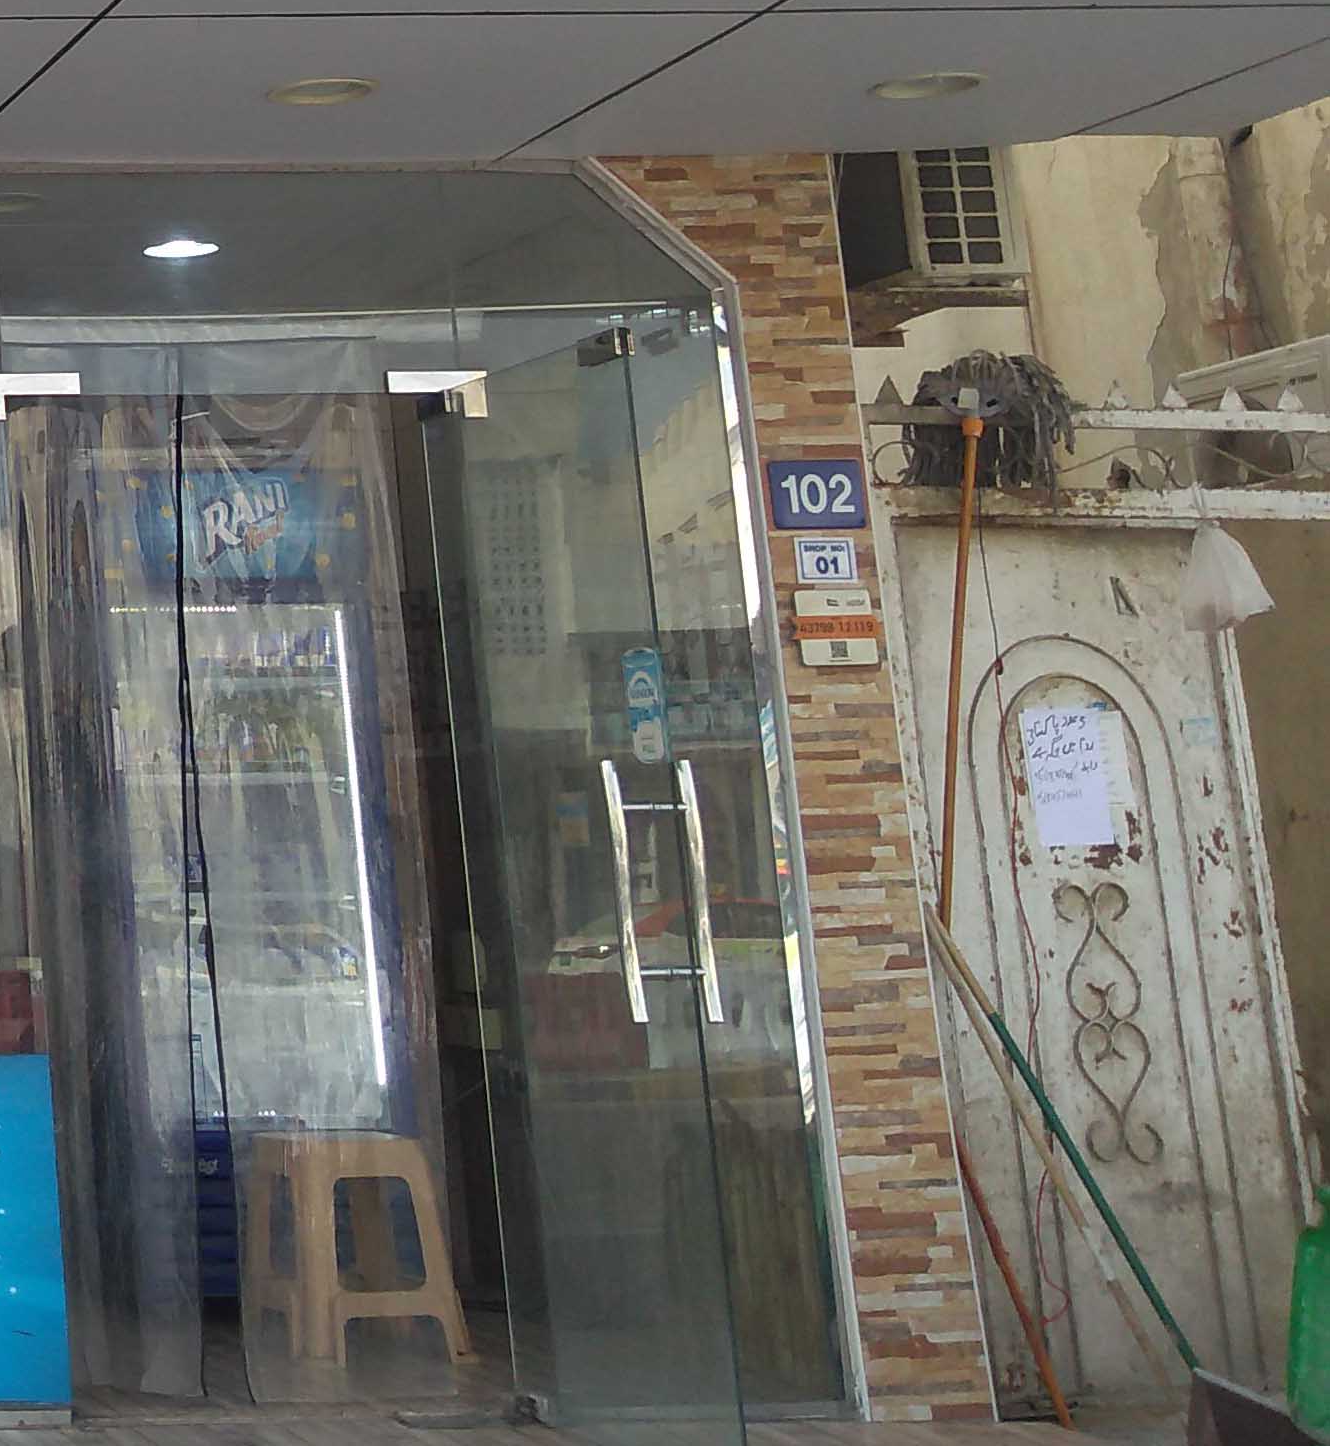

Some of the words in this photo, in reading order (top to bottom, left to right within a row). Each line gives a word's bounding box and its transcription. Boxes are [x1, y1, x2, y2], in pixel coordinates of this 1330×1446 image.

[781, 473, 856, 514] 102
[803, 545, 827, 553] SHOP
[815, 555, 840, 575] 01
